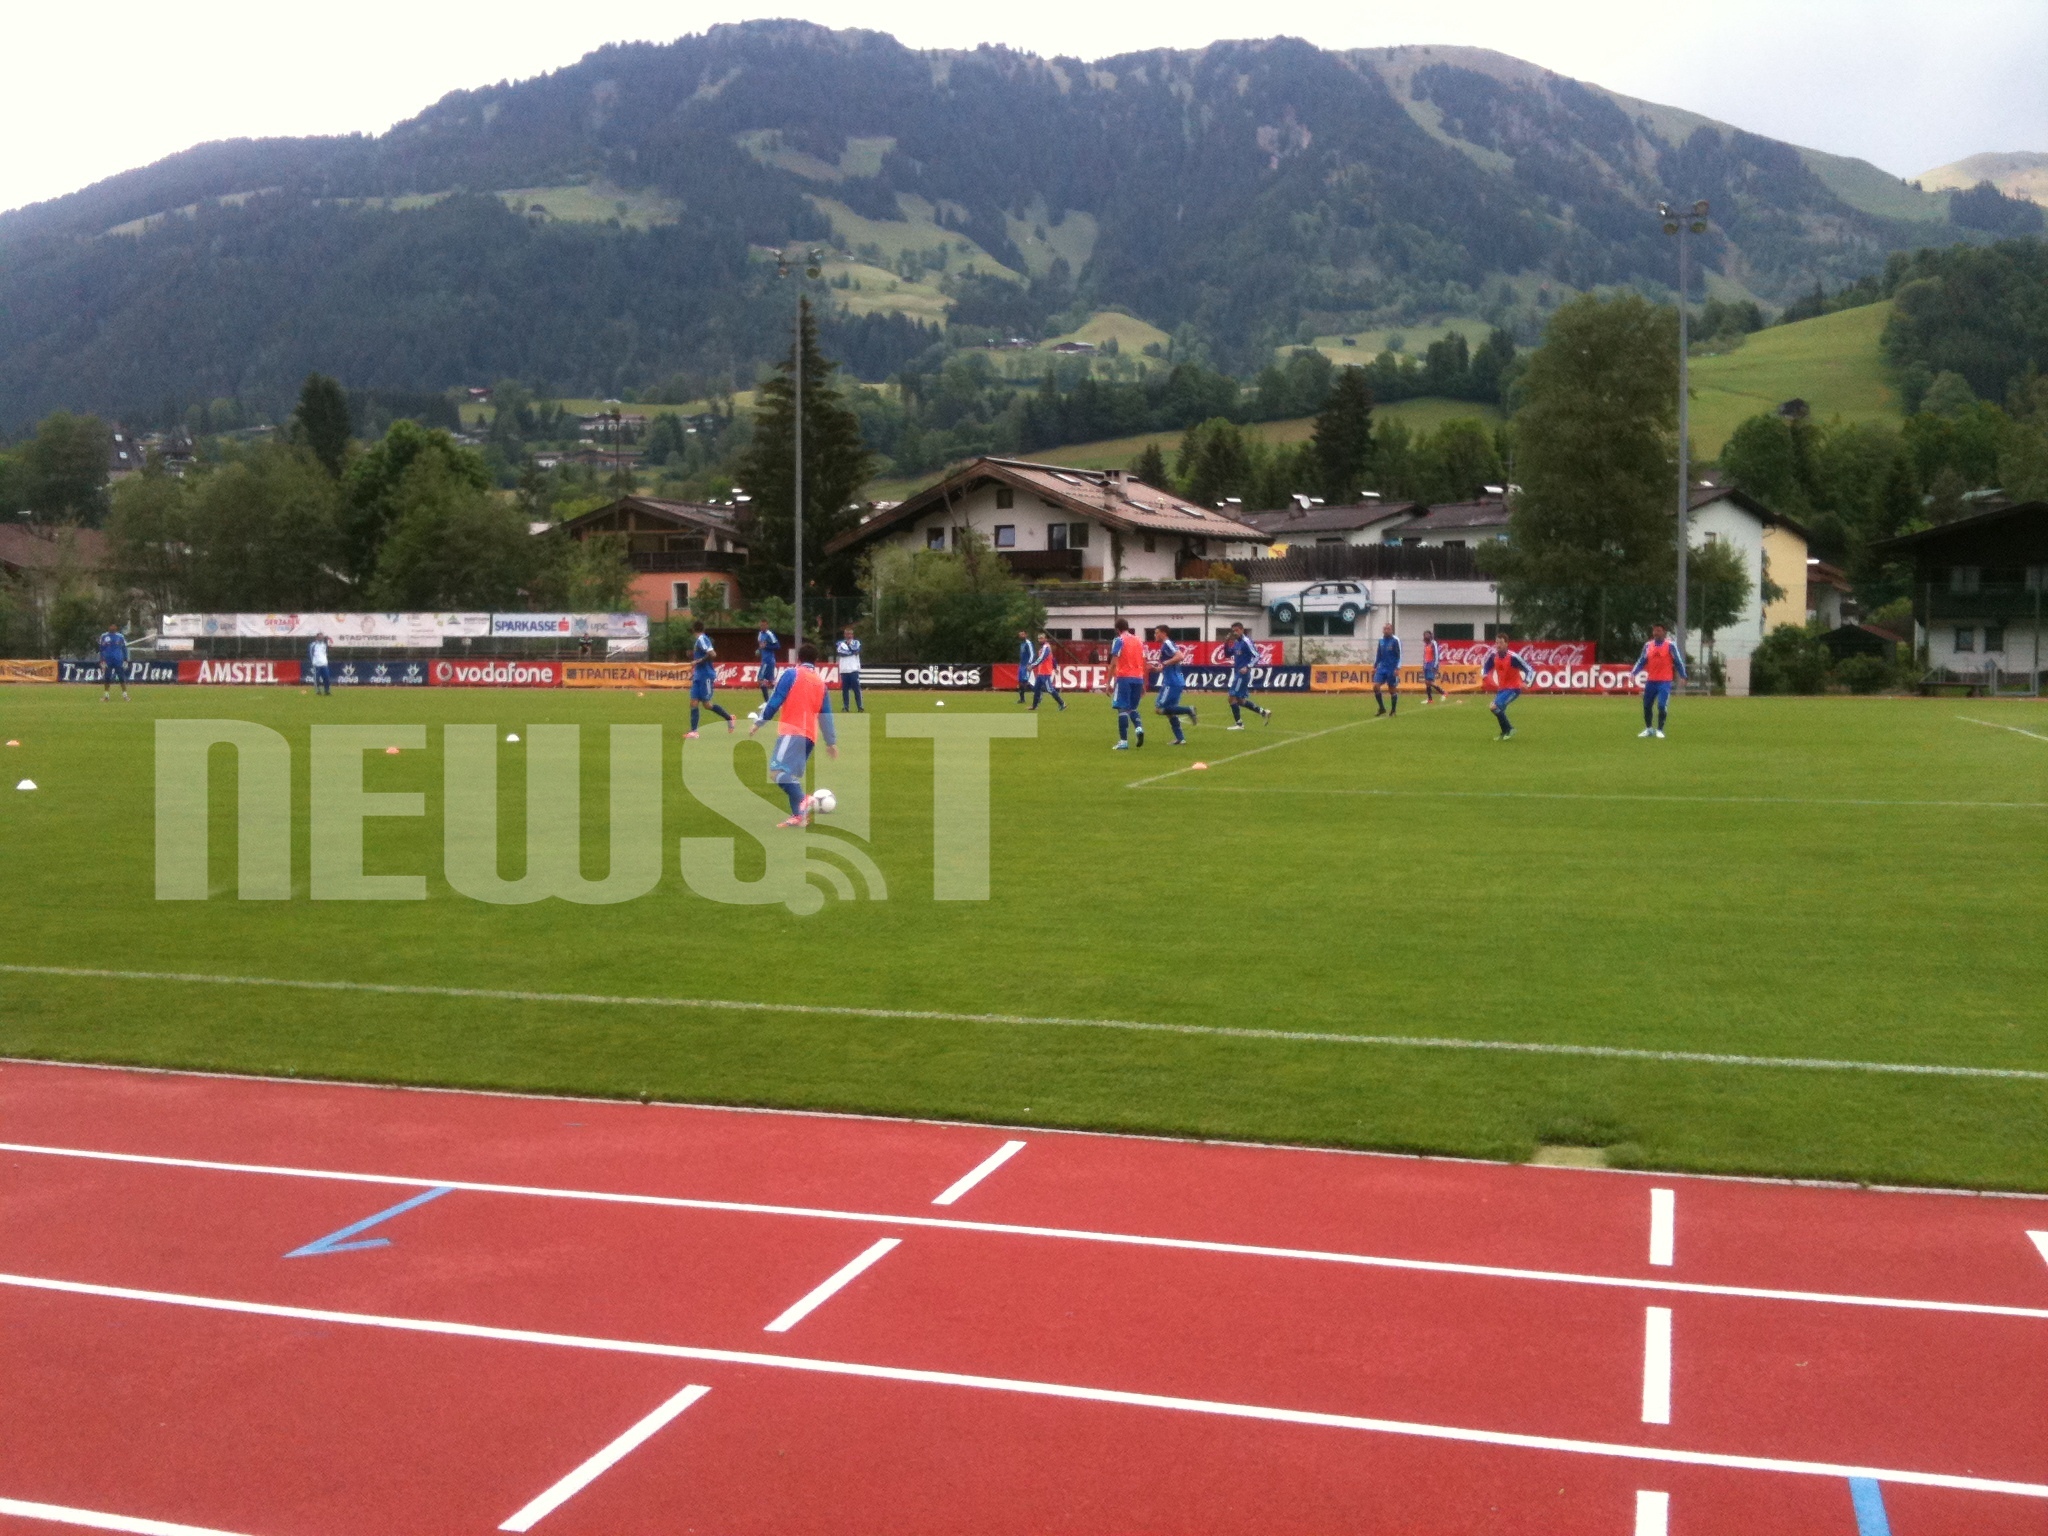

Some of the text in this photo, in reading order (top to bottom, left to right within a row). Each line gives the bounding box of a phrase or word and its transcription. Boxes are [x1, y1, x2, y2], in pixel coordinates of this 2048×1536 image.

[494, 620, 557, 632] SPARKASSE
[62, 662, 119, 681] Trav
[128, 662, 173, 681] Plan
[197, 660, 279, 683] AMSTEL
[455, 661, 553, 683] vodafone
[904, 665, 982, 685] adidas
[1248, 667, 1305, 688] Plan
